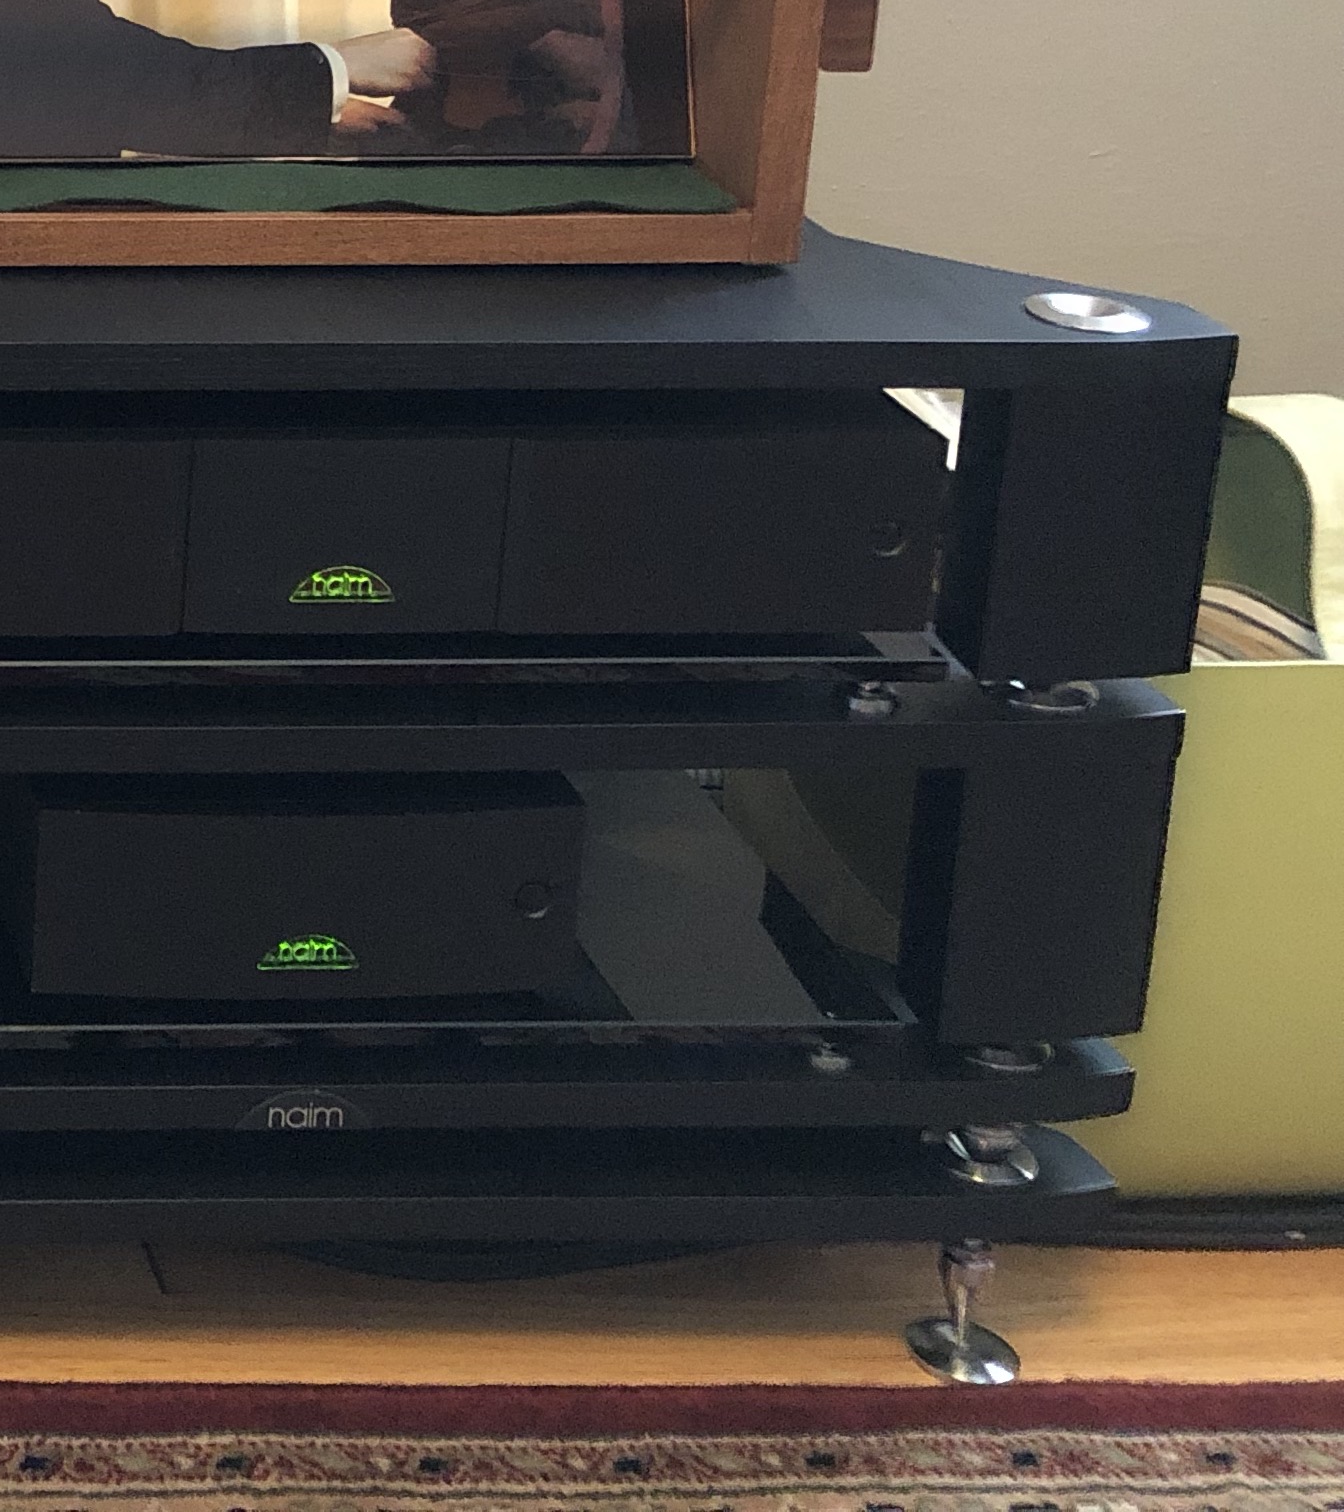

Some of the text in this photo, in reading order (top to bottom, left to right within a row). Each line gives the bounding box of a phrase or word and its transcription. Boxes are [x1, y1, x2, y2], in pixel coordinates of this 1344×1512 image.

[312, 572, 373, 597] naim
[278, 939, 337, 962] naim
[267, 1101, 344, 1129] naim
